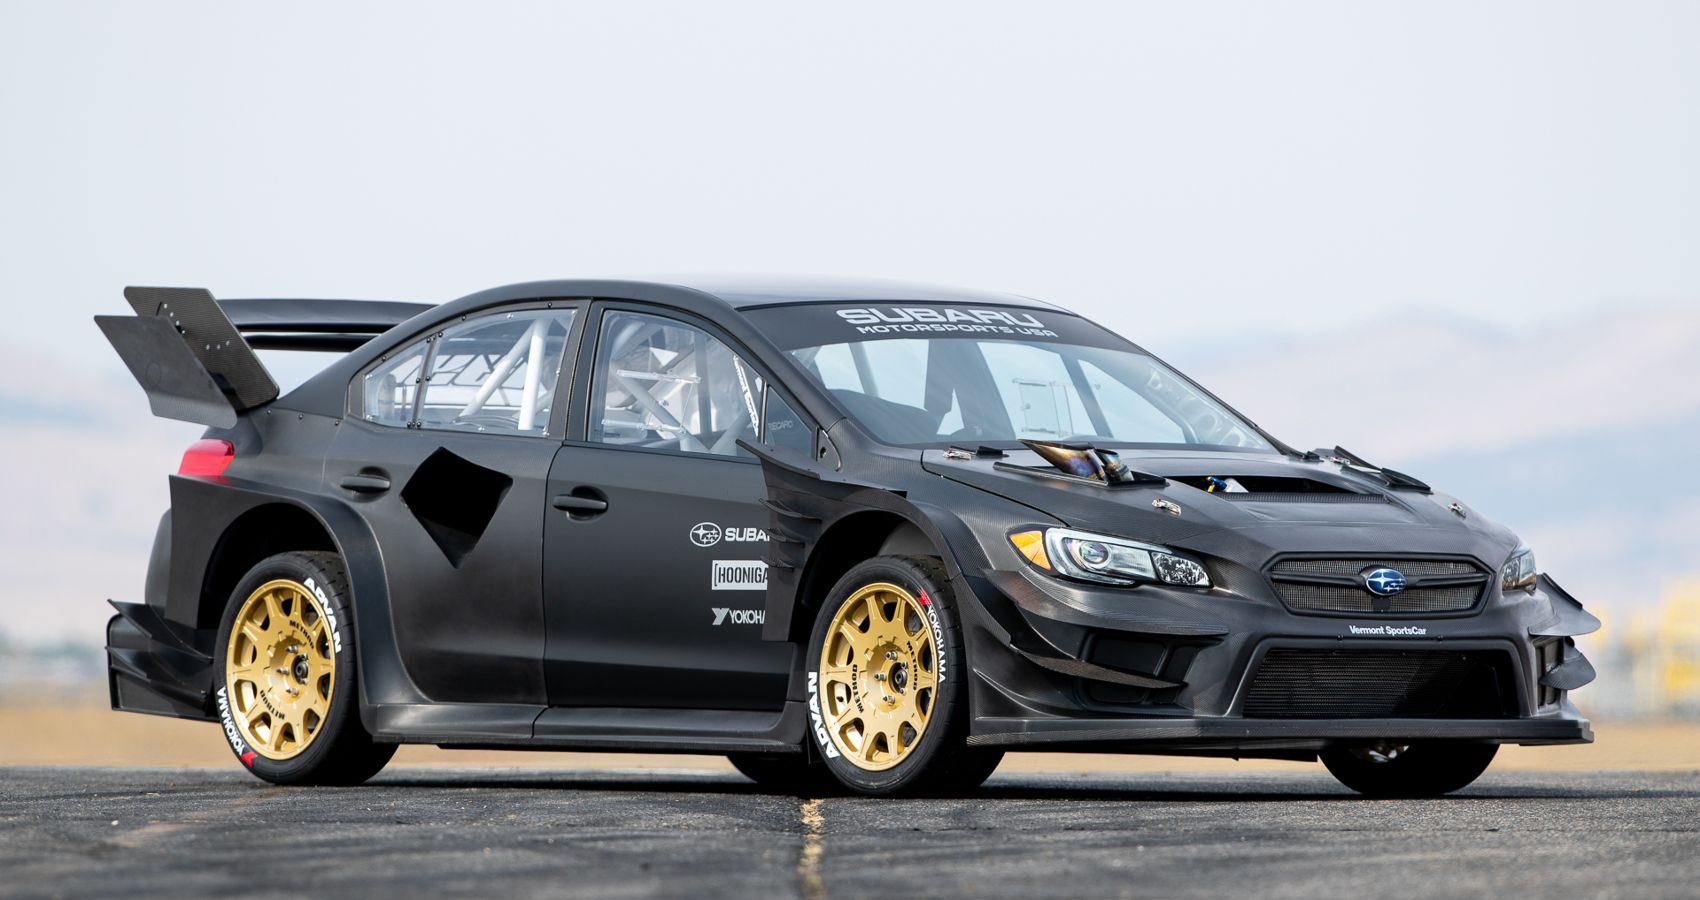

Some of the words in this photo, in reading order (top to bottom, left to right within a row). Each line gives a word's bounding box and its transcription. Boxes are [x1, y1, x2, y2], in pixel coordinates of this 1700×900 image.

[836, 307, 1045, 328] SUBARU
[856, 323, 1015, 334] MOTORSPORTS
[1017, 327, 1059, 338] USA
[289, 619, 315, 650] METHOD
[304, 577, 342, 653] ADVAN
[1349, 625, 1385, 635] Vermont
[1385, 626, 1427, 636] SportsCar
[906, 640, 919, 691] METHOD
[927, 605, 947, 684] YOKOHAMA
[852, 664, 865, 713] METHOD
[217, 686, 244, 755] YOKOHAMA
[808, 671, 840, 759] ADVAN
